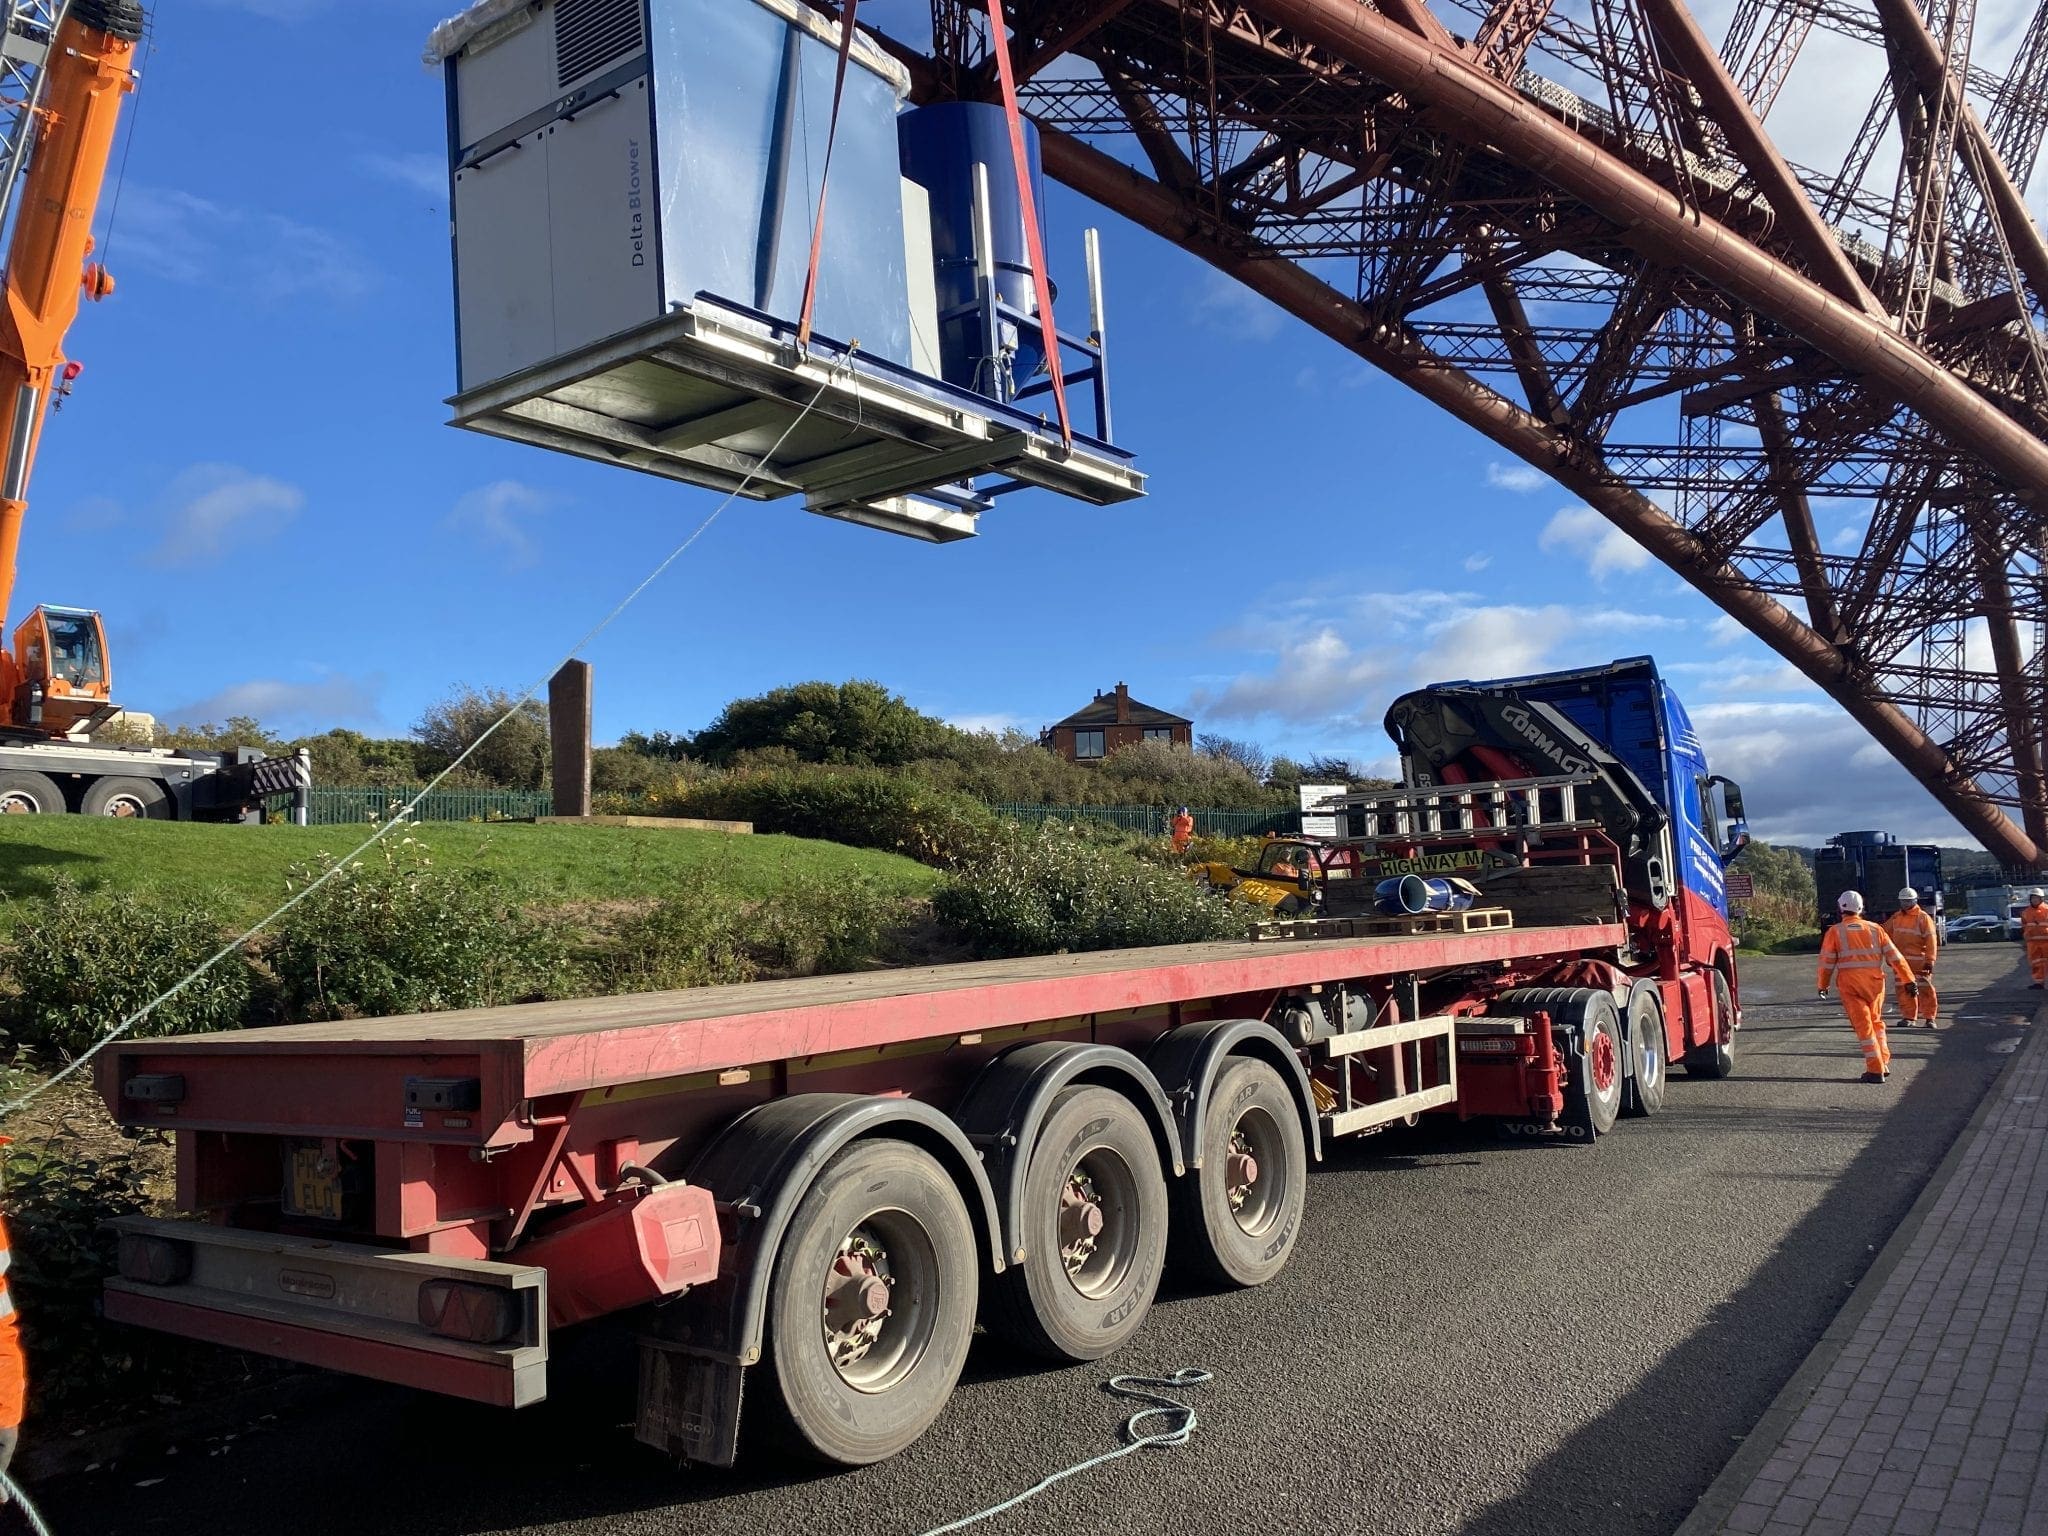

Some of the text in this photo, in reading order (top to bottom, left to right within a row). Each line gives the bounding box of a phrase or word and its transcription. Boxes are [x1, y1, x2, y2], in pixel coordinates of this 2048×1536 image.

[628, 138, 644, 267] Delta Blower
[1380, 852, 1459, 876] HIGHWAY
